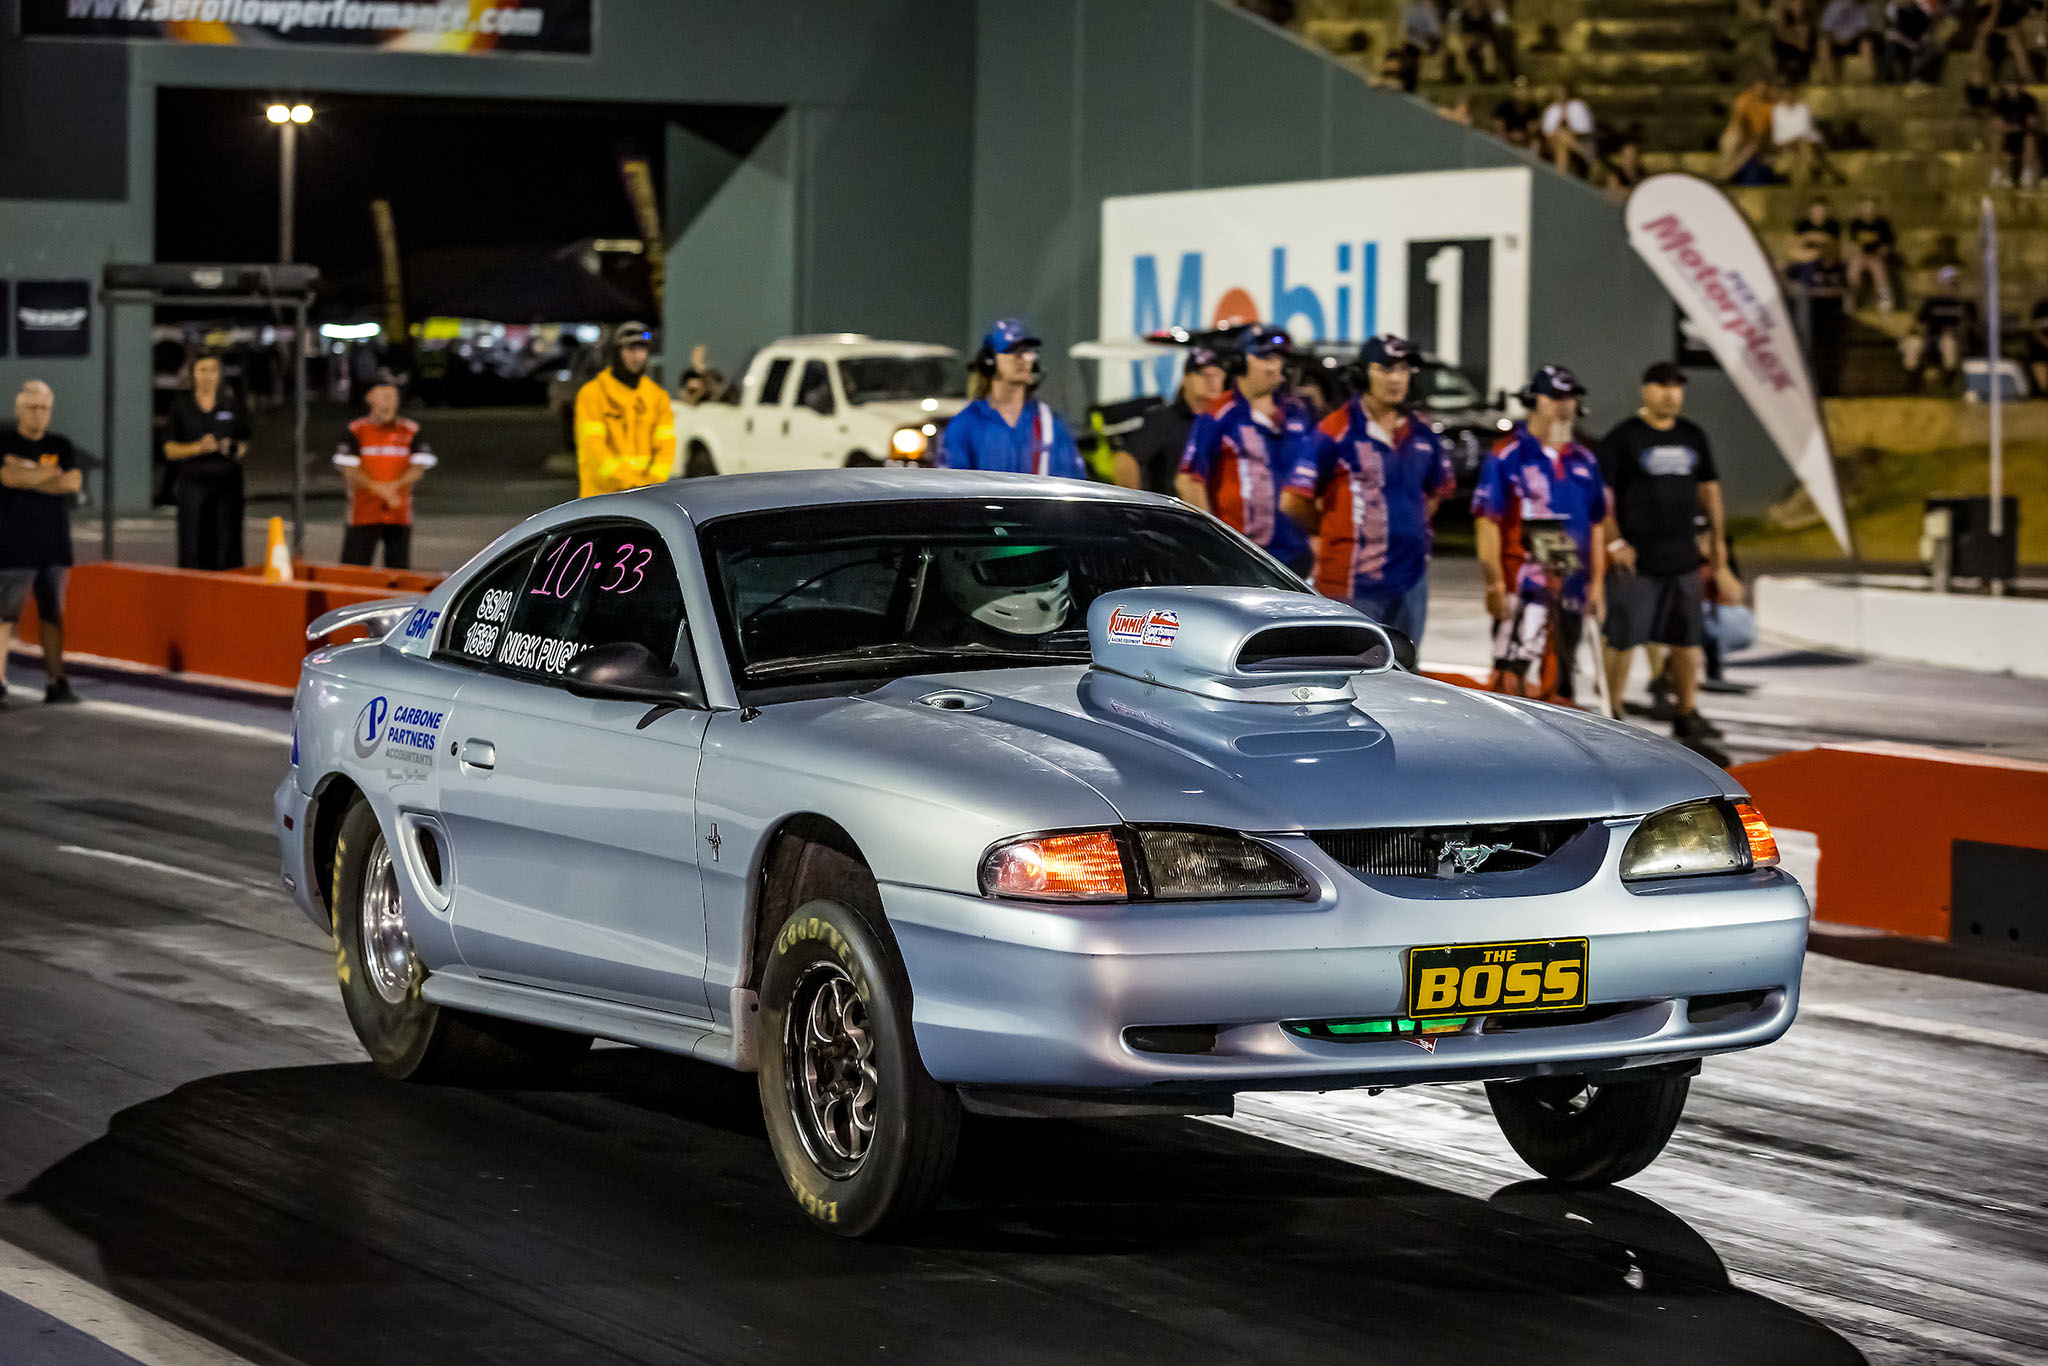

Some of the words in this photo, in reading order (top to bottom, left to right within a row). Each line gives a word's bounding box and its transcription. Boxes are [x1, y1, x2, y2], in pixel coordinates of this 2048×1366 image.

[1642, 214, 1795, 392] Motorplex
[405, 608, 440, 640] GMF
[1108, 606, 1147, 633] SUMMIT
[463, 622, 500, 658] 1533
[499, 630, 542, 669] NICK
[394, 706, 443, 729] CARBONE
[387, 726, 436, 750] PARTNERS
[385, 747, 433, 767] ACCOUNTANTS
[1483, 949, 1517, 963] THE
[1416, 959, 1581, 1010] BOSS
